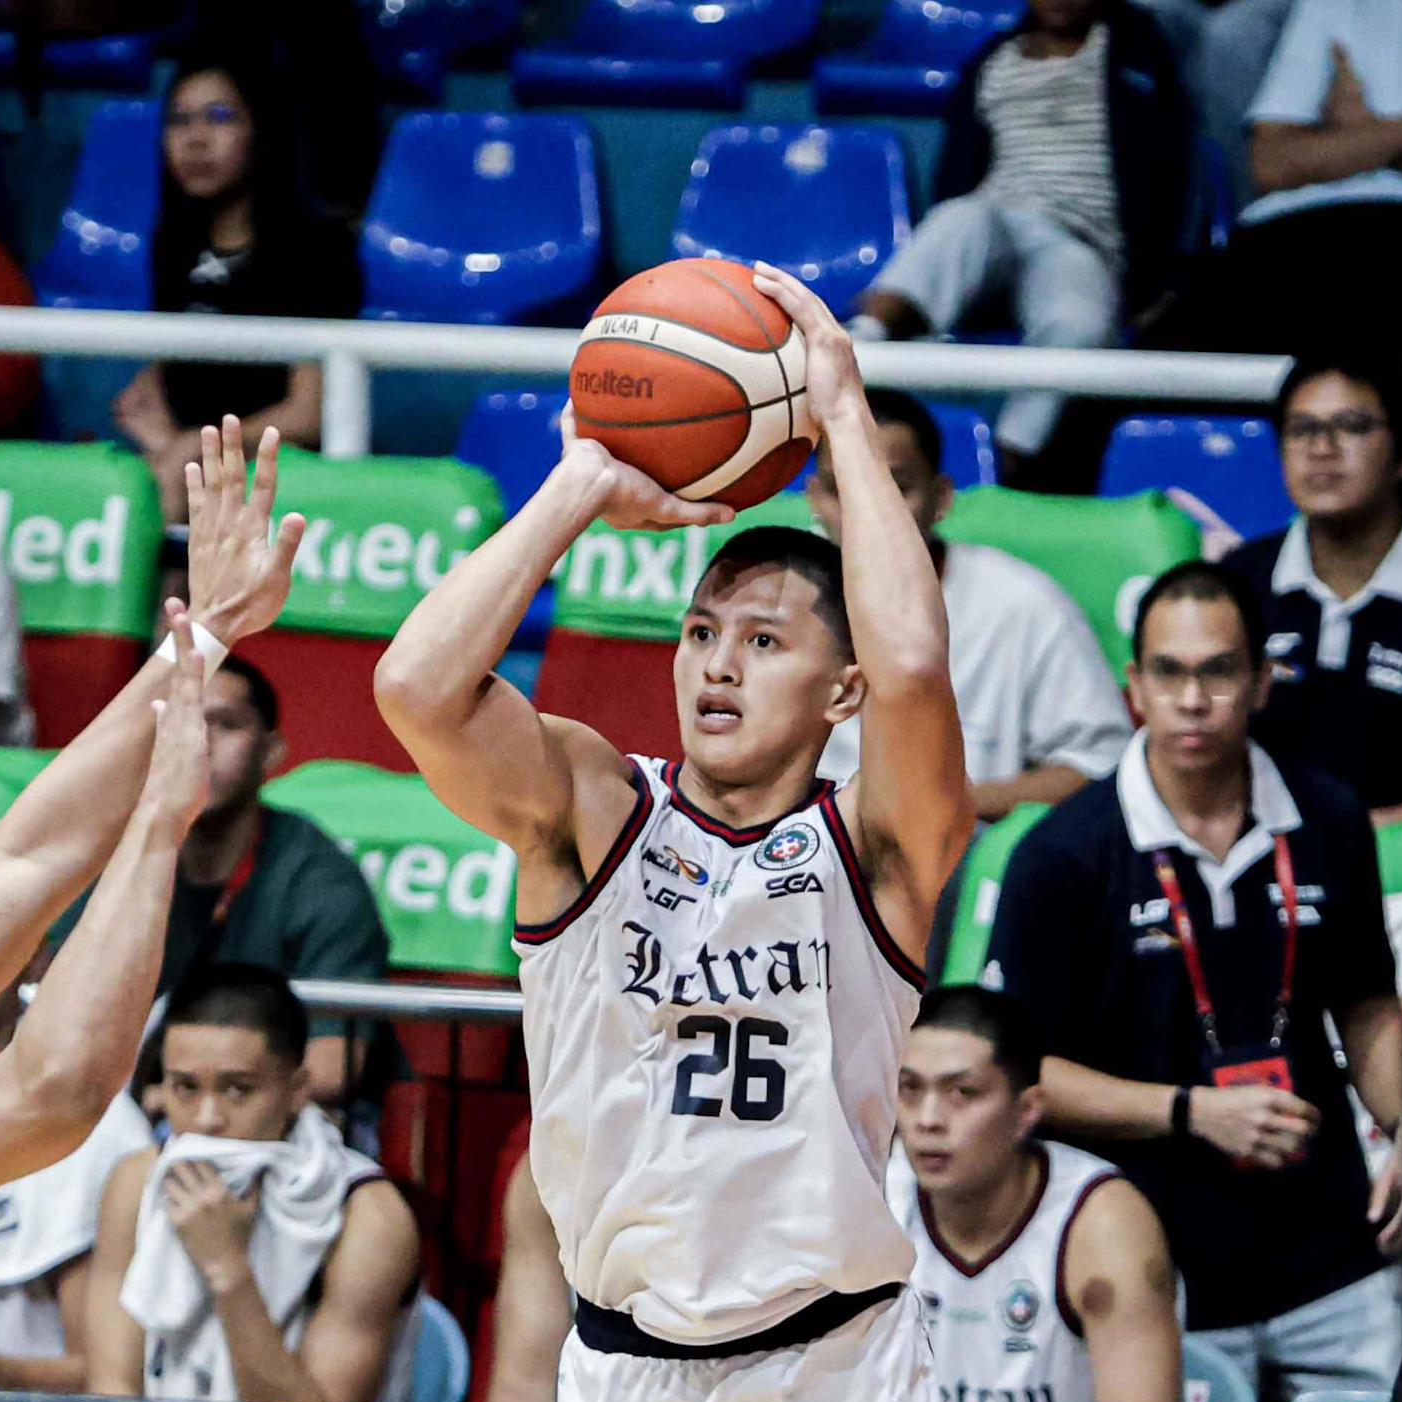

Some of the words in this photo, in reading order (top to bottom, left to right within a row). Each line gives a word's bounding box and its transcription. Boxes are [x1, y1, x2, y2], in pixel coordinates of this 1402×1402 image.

[575, 369, 654, 399] molten
[621, 920, 832, 1007] Letran
[671, 1014, 789, 1121] 26
